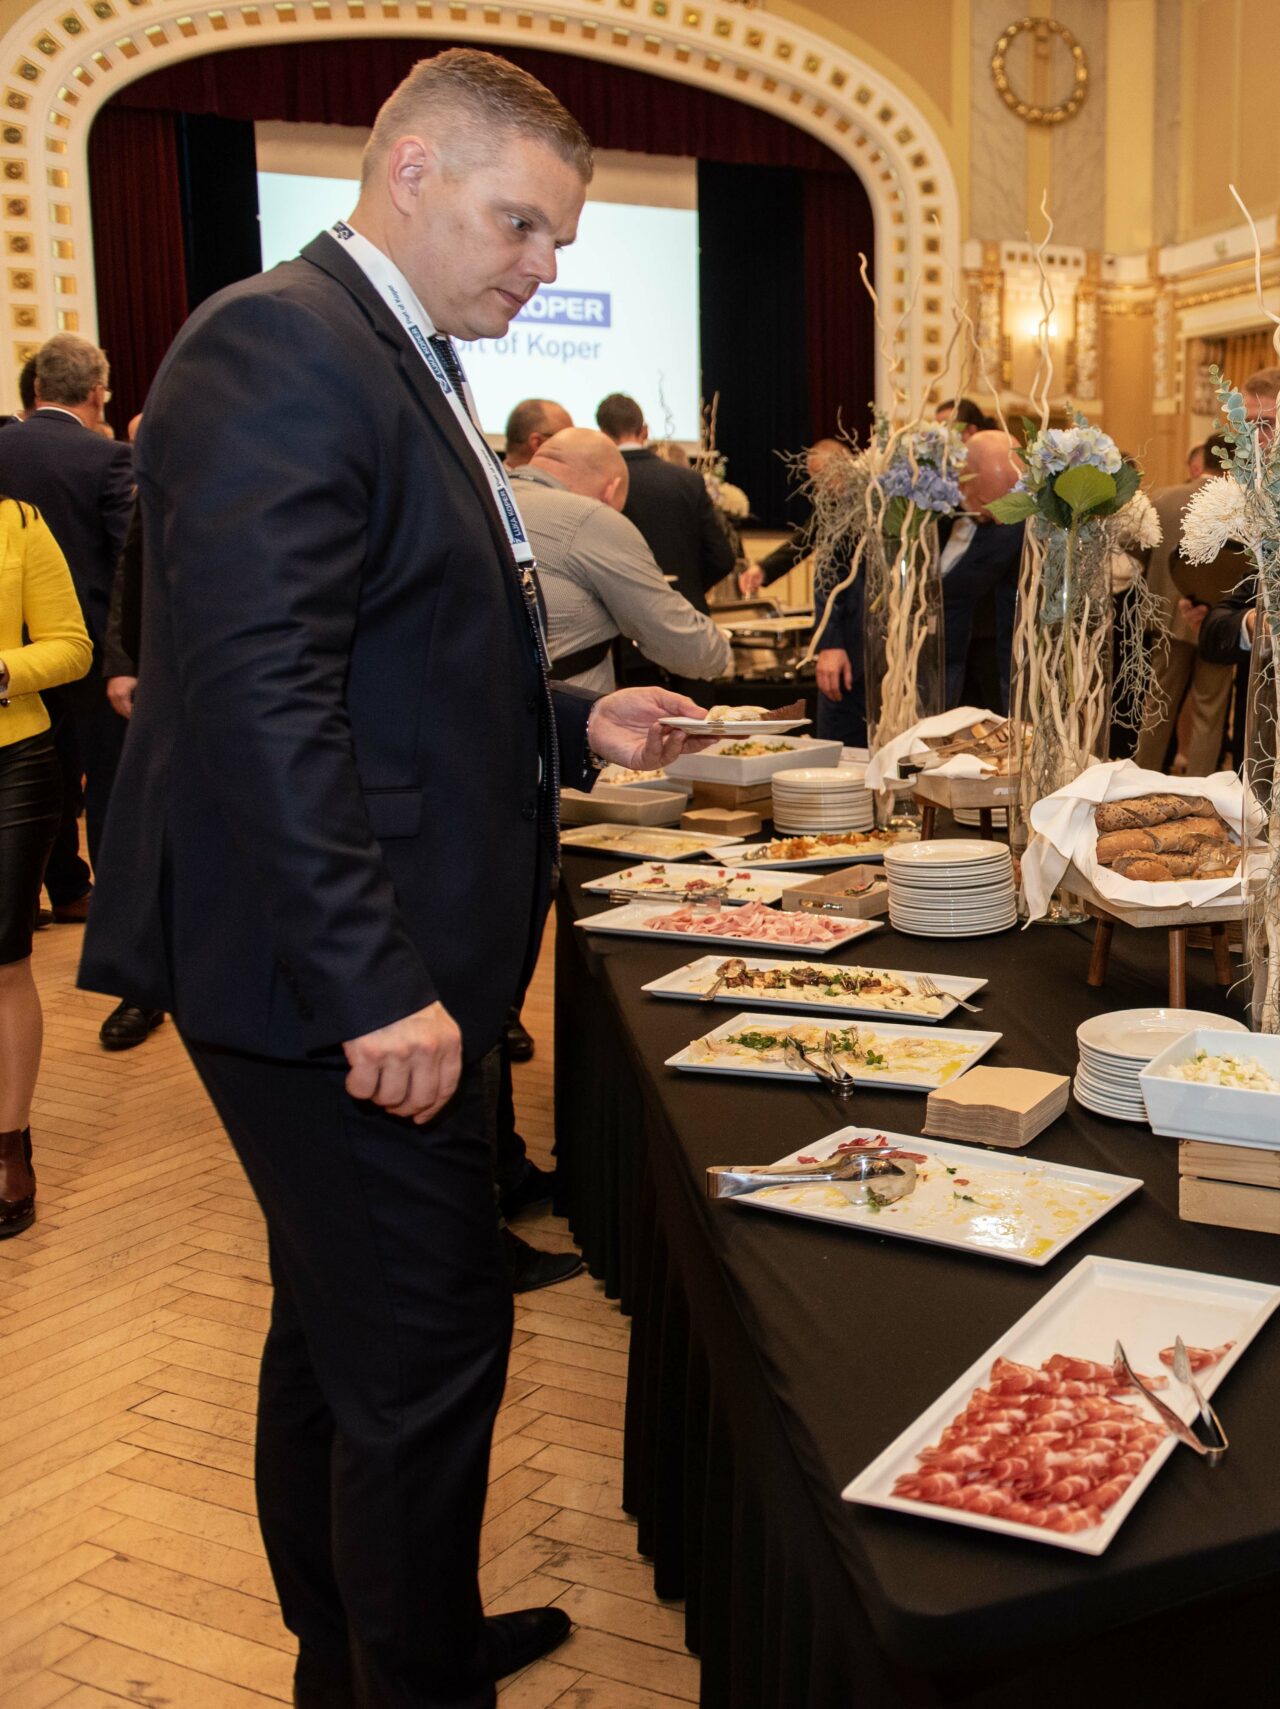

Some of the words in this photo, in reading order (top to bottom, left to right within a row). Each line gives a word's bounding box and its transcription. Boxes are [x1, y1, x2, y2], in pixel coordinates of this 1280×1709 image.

[411, 328, 430, 355] KOPER
[494, 331, 519, 355] of
[527, 332, 602, 364] Koper
[427, 354, 443, 376] LUKA
[499, 489, 515, 517] KOPER
[509, 517, 523, 537] LUKA
